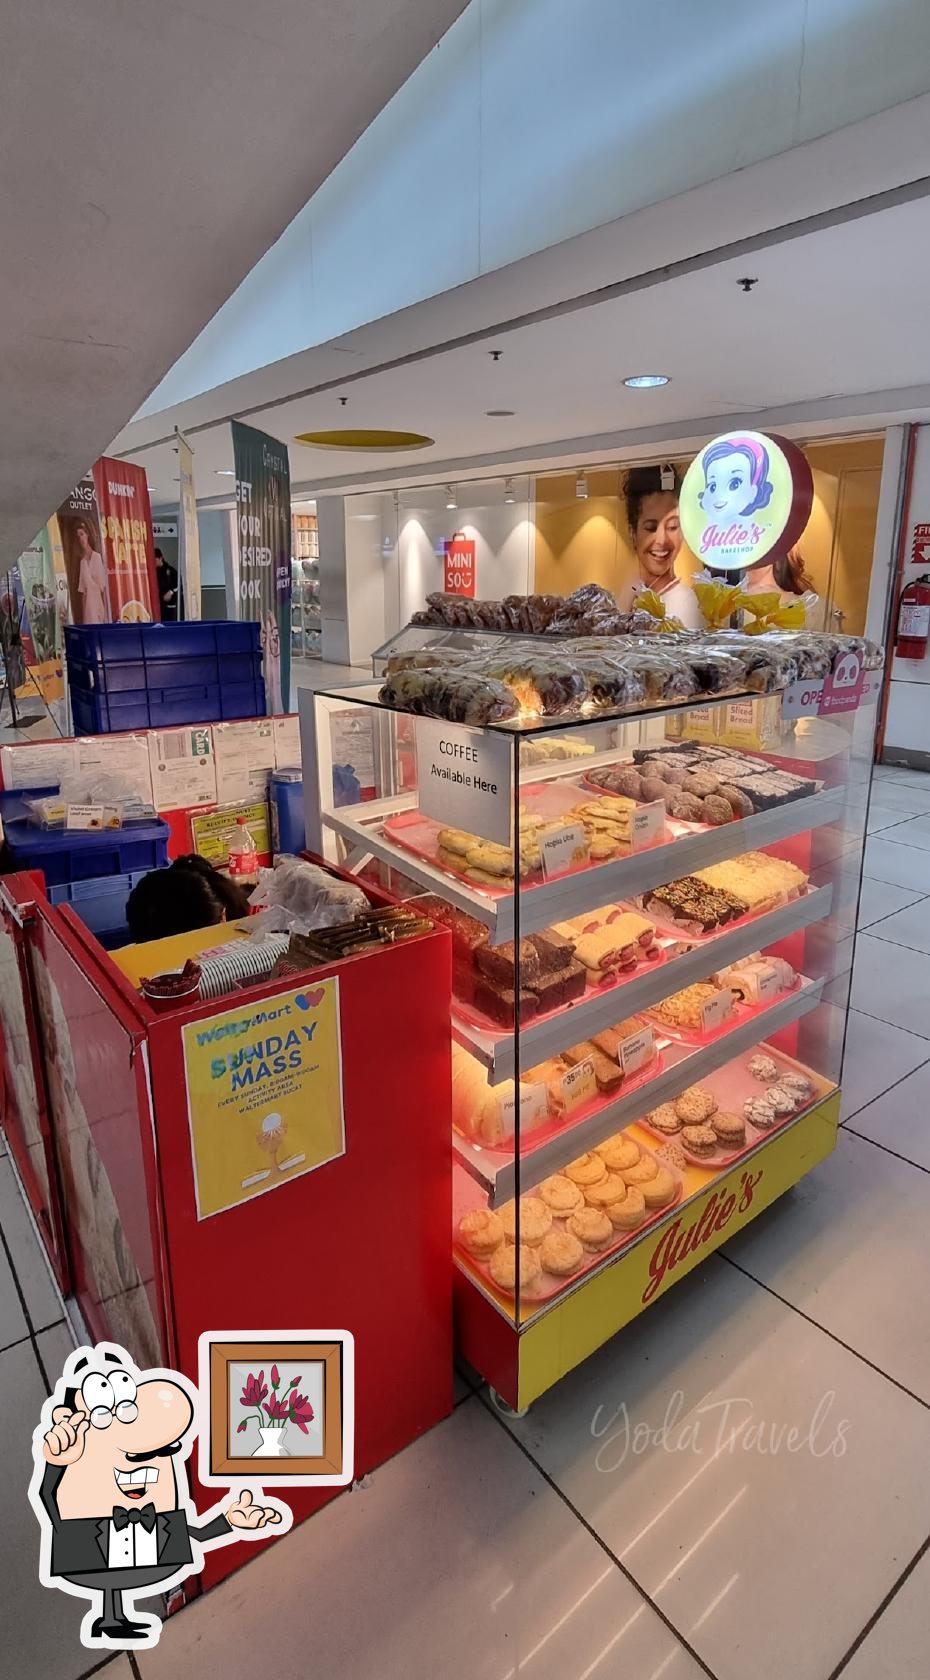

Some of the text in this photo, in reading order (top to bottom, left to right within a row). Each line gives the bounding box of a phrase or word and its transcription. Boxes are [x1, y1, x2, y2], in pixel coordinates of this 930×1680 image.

[236, 480, 252, 504] GET
[69, 501, 93, 510] OUTLET
[239, 515, 261, 537] OUR
[699, 522, 766, 554] Julie's
[447, 552, 472, 568] MINI
[240, 579, 261, 601] OOK
[800, 688, 824, 706] OPE
[439, 740, 479, 763] COFFEE
[430, 764, 498, 795] Available Here
[210, 1021, 318, 1079] SUNDAY
[231, 1049, 302, 1092] MASS
[641, 1169, 764, 1304] Julie's
